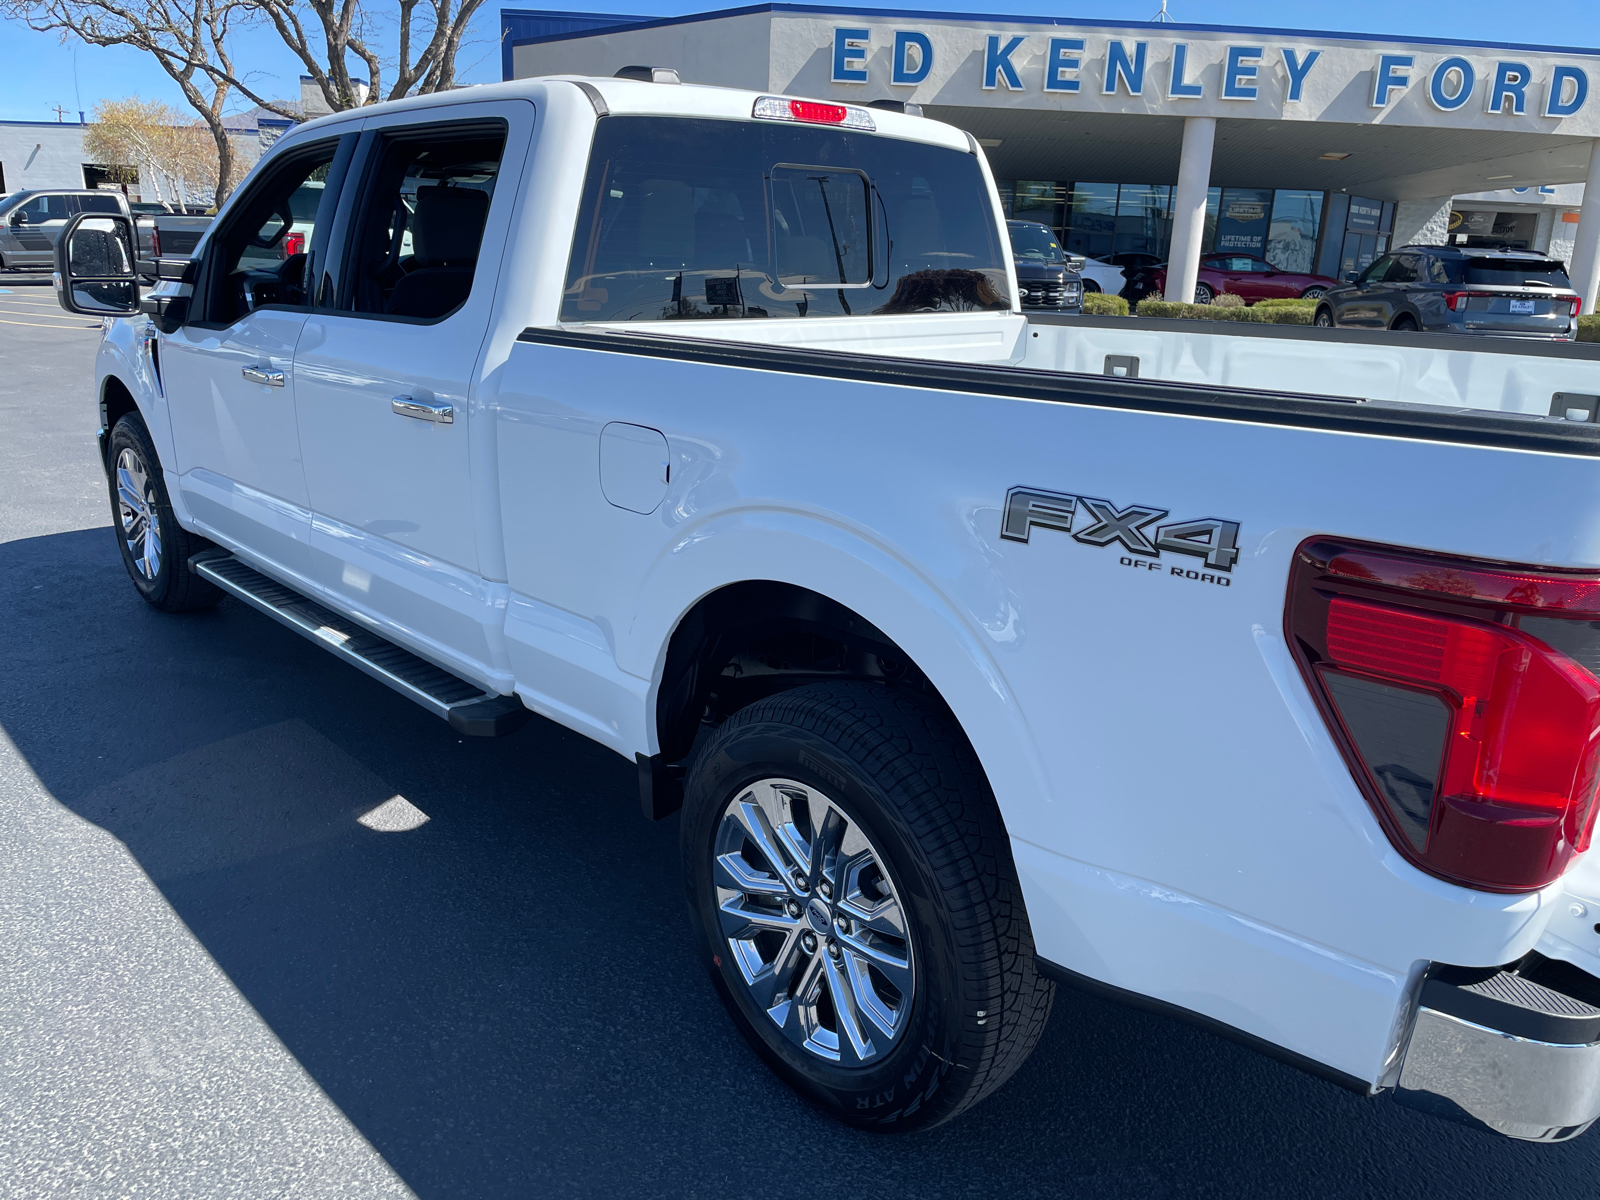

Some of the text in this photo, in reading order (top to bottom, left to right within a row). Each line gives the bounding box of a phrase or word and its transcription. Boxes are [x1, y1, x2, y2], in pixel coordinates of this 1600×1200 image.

[831, 26, 1589, 118] ED KENLEY FORD
[1220, 240, 1262, 248] PROTECTION
[1252, 235, 1263, 243] OF
[999, 484, 1242, 573] FX4
[1119, 556, 1232, 587] OFF ROAD
[799, 750, 848, 792] PIRELLI
[855, 1085, 896, 1110] ATR
